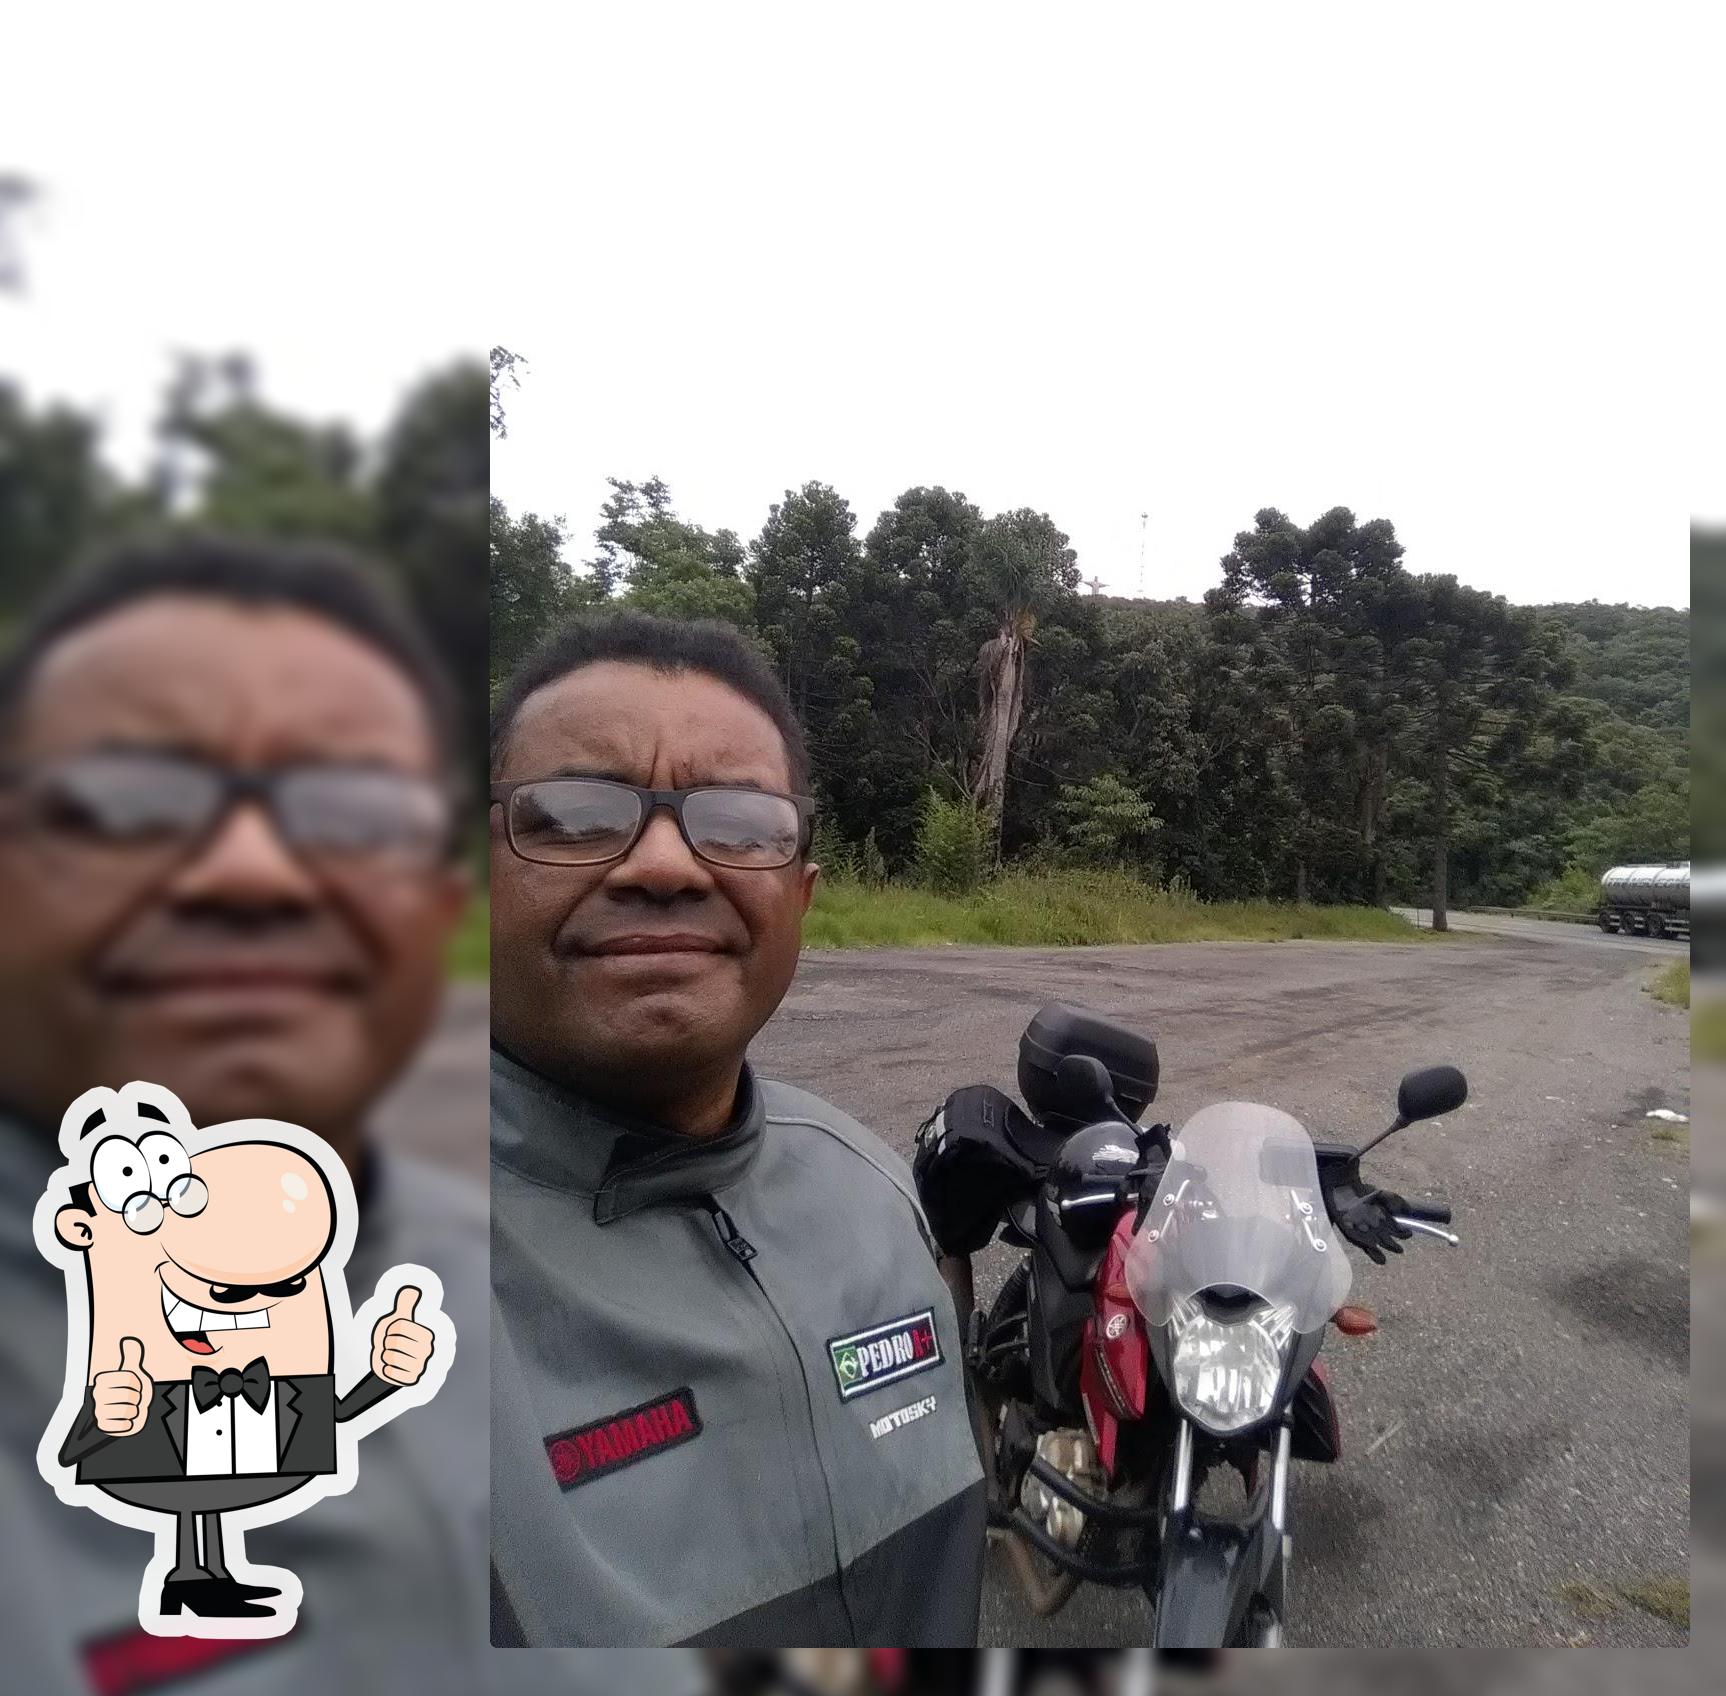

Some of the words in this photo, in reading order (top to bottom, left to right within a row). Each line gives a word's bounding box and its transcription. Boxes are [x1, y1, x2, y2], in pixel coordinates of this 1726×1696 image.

[856, 1331, 914, 1378] PEDRO
[576, 1399, 694, 1469] YAMAHA
[869, 1395, 936, 1439] MOTOSKY
